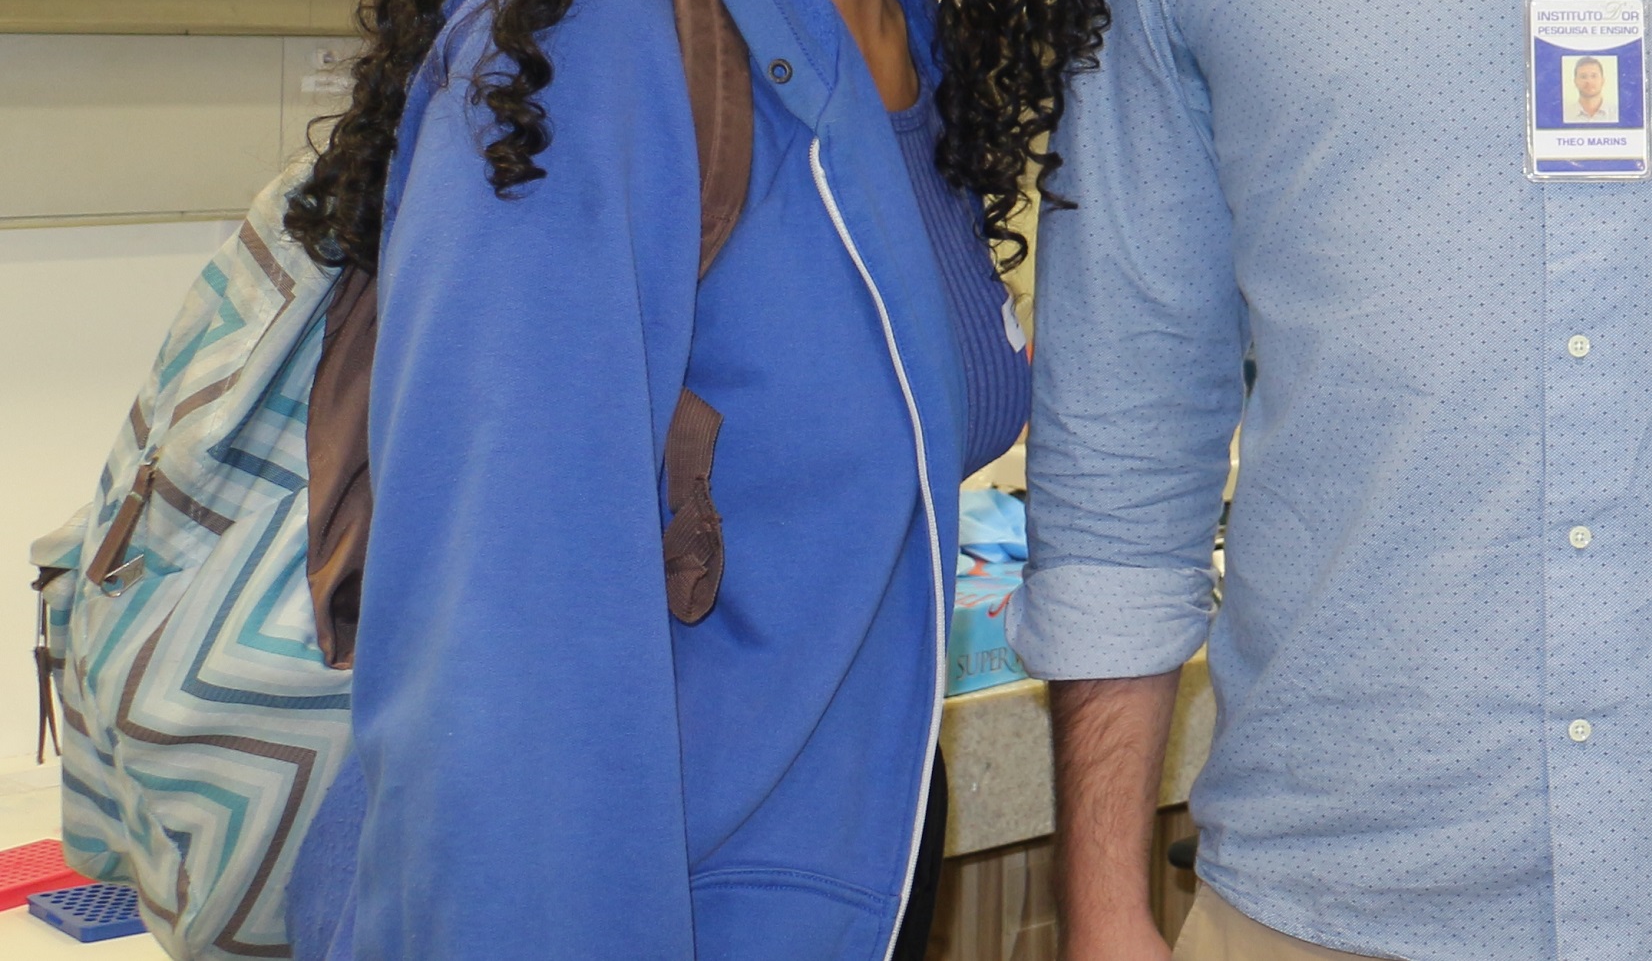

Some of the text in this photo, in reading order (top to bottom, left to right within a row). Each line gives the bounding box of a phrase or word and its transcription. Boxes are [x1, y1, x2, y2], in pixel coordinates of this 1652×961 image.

[1537, 10, 1603, 21] INSTITUTO
[1538, 25, 1639, 35] PESQUISA E ENSINO
[1556, 137, 1628, 146] THEO MARINS
[957, 647, 1018, 681] SUPER
